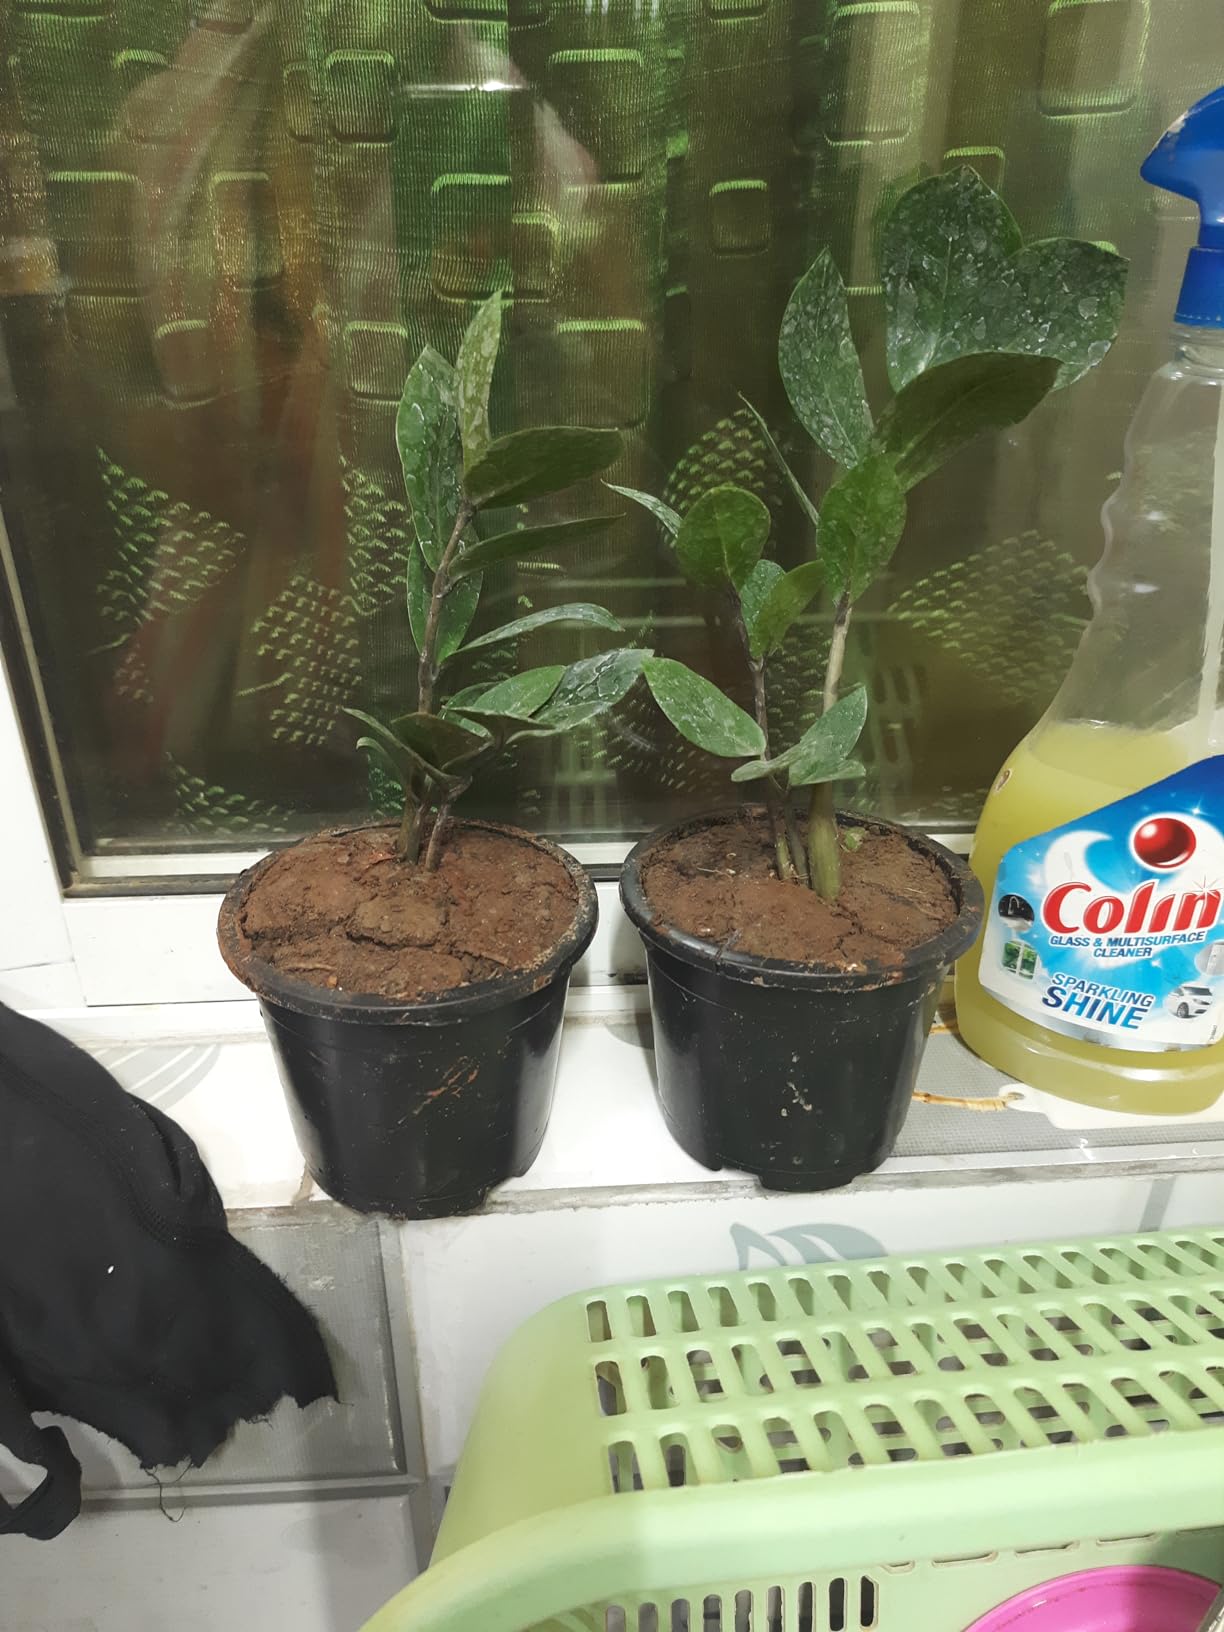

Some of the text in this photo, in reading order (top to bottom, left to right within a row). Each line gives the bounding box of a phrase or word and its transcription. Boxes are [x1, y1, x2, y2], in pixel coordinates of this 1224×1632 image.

[1043, 882, 1220, 934] Colin
[1050, 932, 1206, 947] GLASS & MULTISURFACE
[1093, 948, 1152, 957] CLEANER
[1052, 974, 1155, 1007] SPARKLING
[1042, 987, 1148, 1029] SHINE
